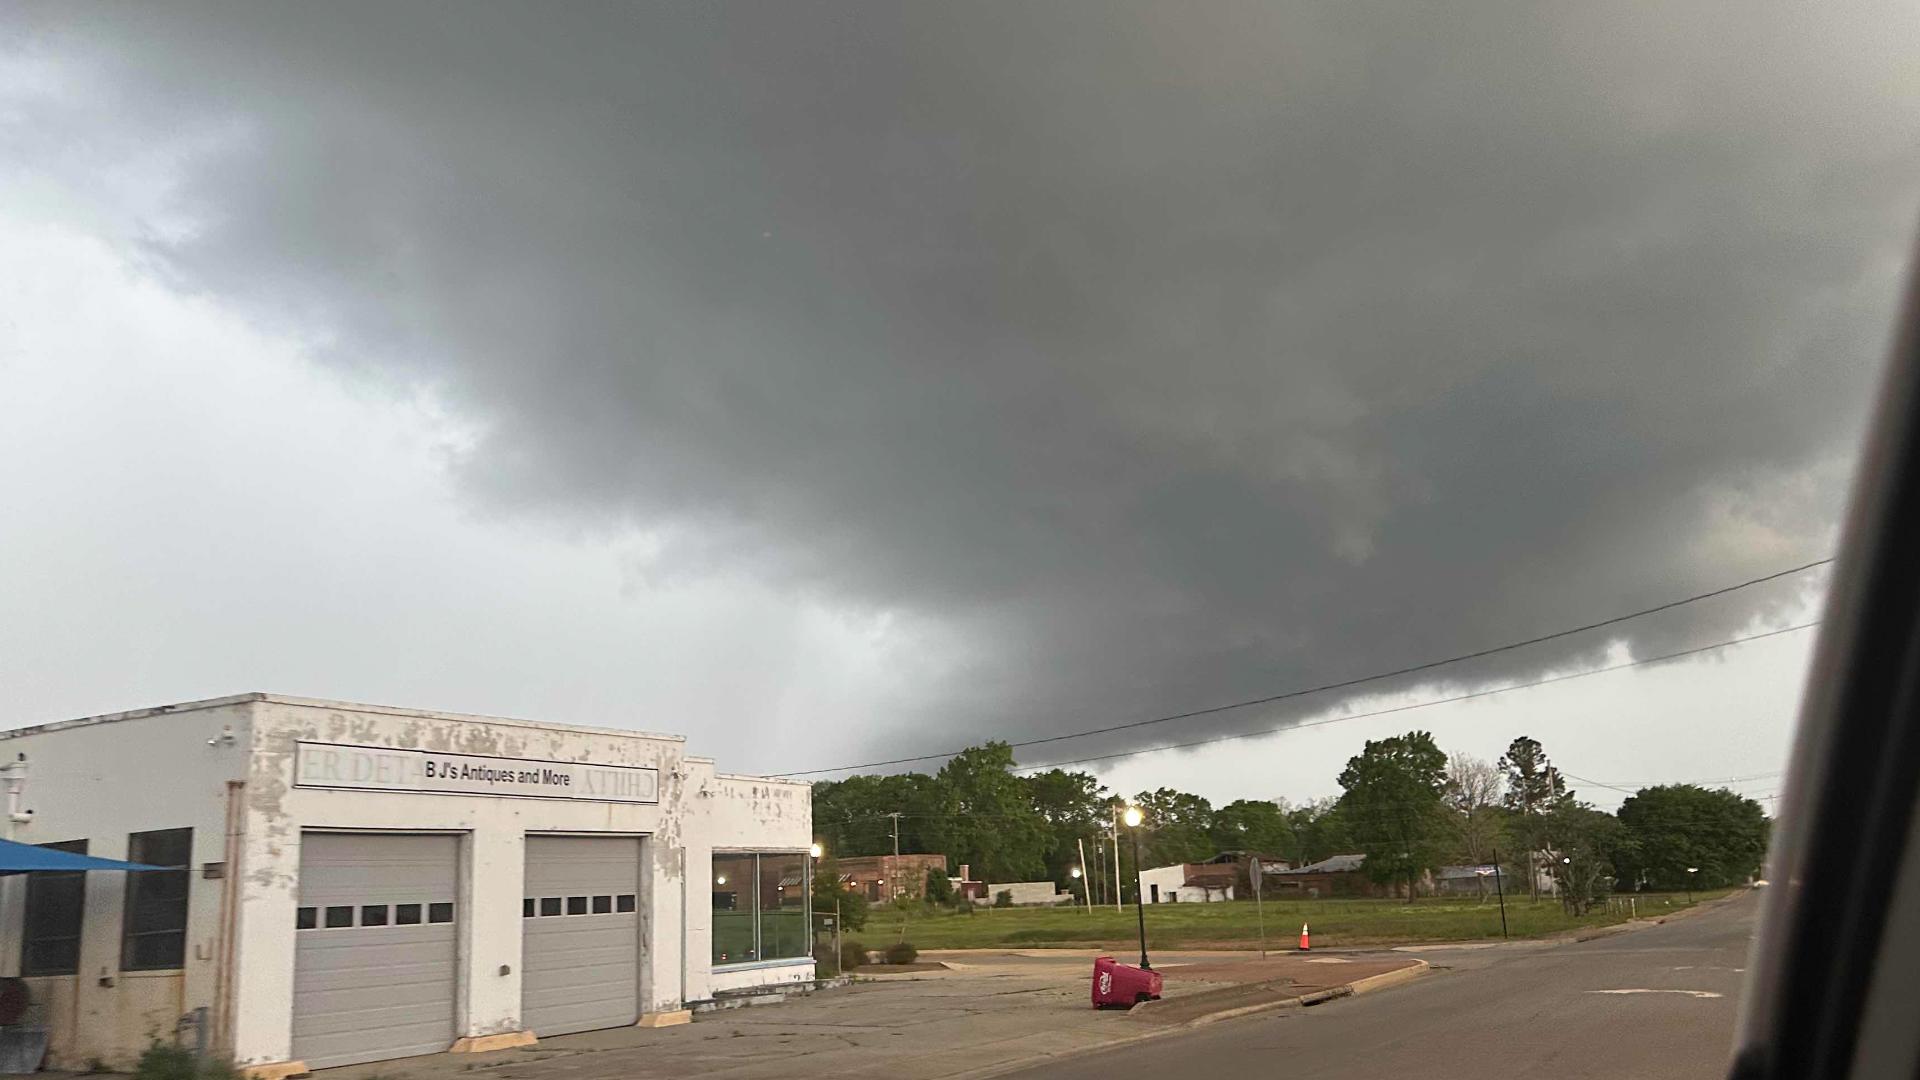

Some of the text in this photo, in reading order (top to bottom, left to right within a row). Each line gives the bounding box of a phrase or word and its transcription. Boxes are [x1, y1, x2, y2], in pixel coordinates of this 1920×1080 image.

[425, 761, 570, 786] B J's Antiques and More
